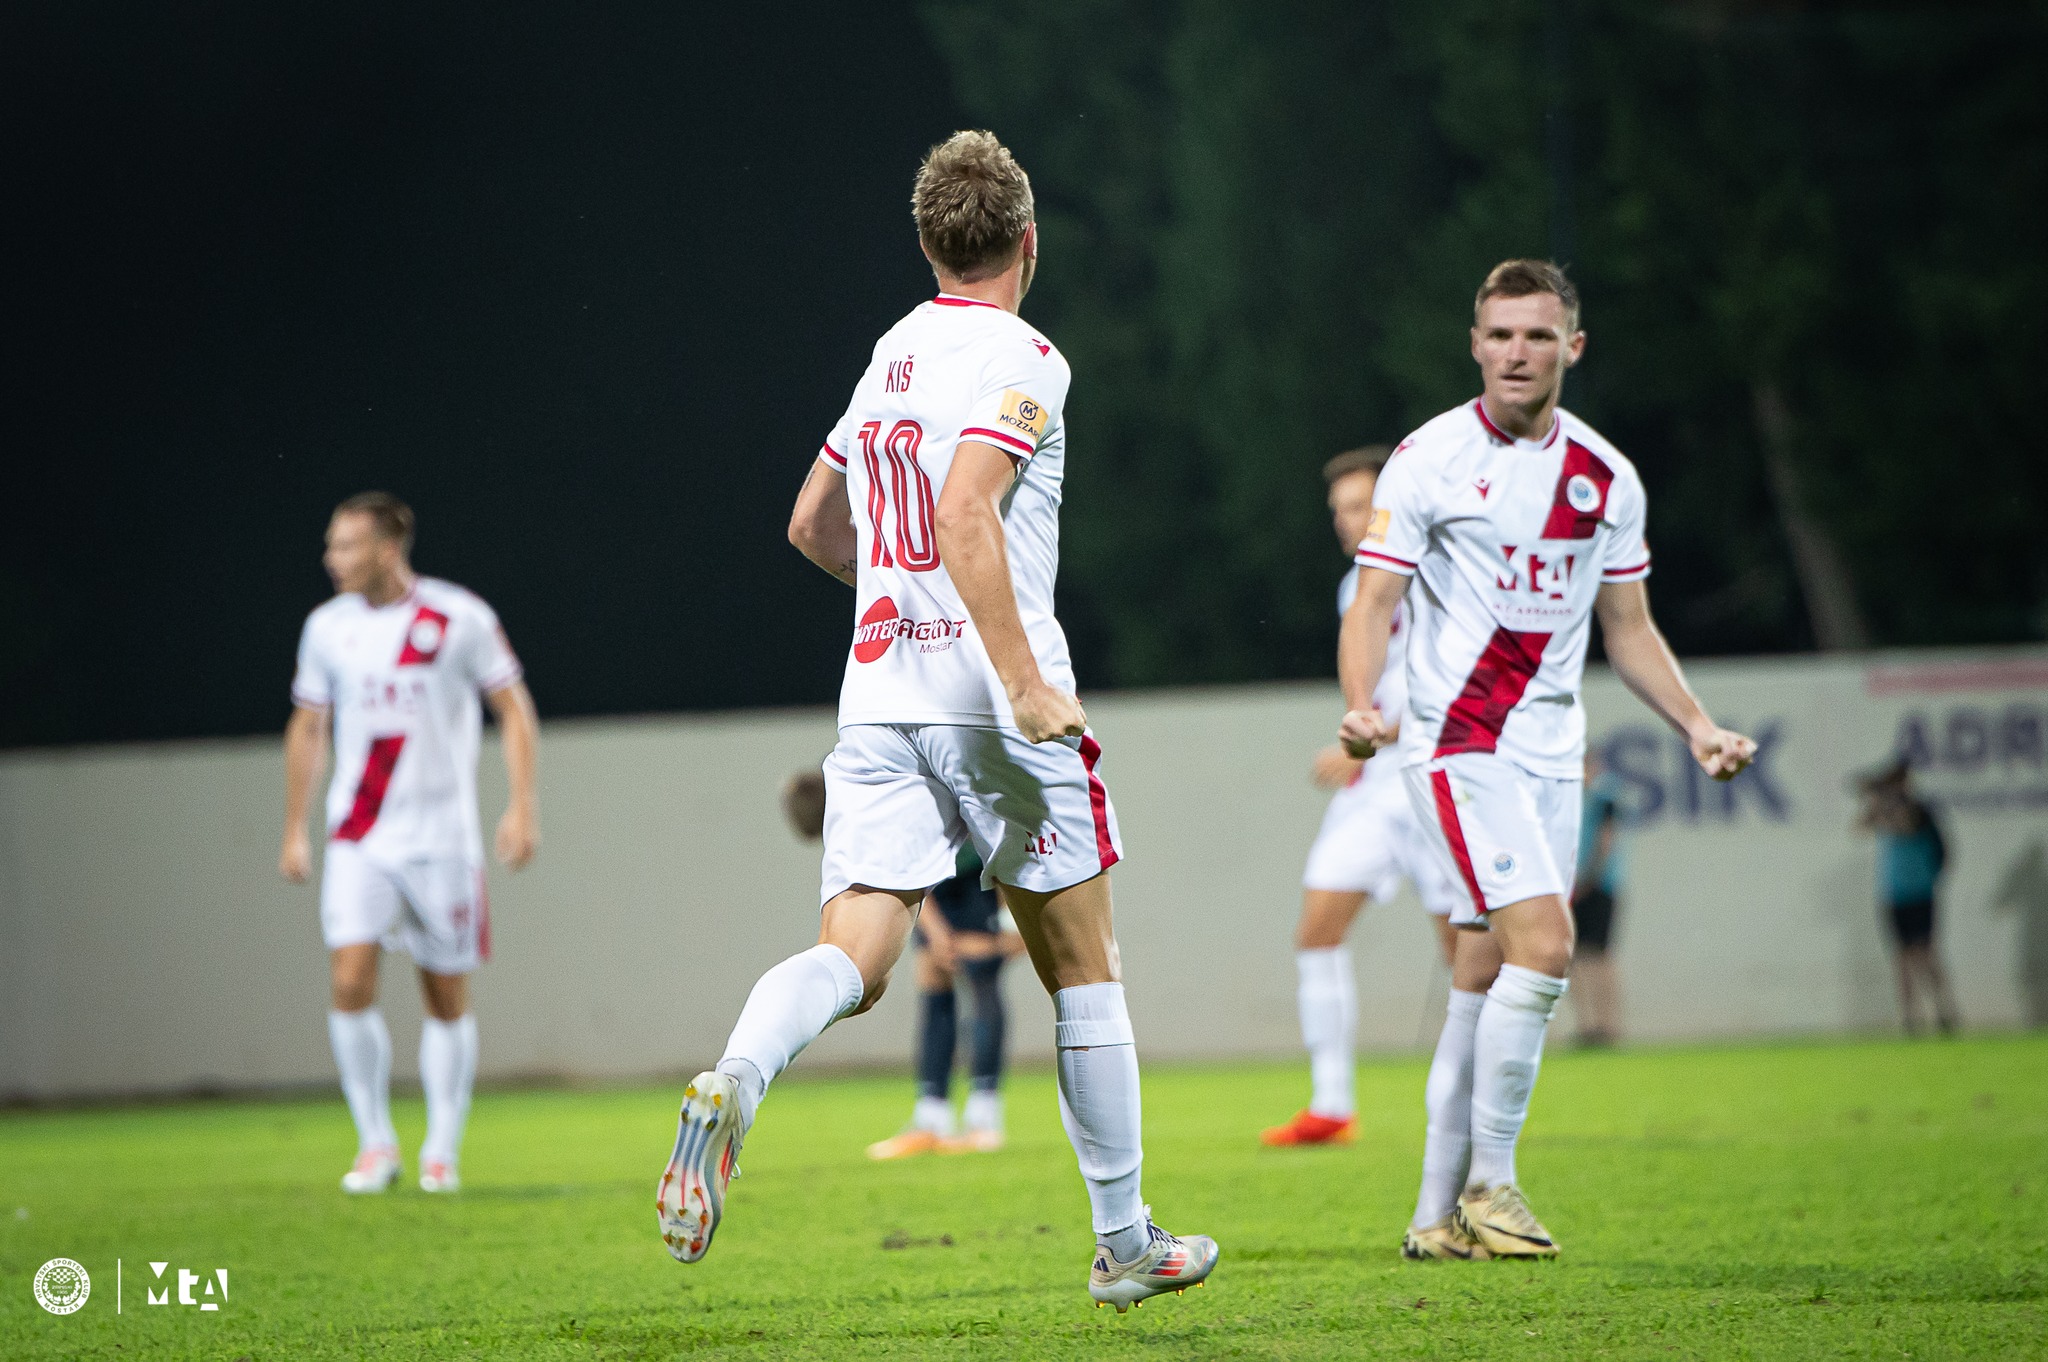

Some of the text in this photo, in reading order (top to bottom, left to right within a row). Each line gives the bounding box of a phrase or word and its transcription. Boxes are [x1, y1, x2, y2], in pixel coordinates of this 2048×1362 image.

[885, 354, 914, 393] KIŠ
[857, 419, 941, 573] 10
[919, 641, 954, 654] Mostar
